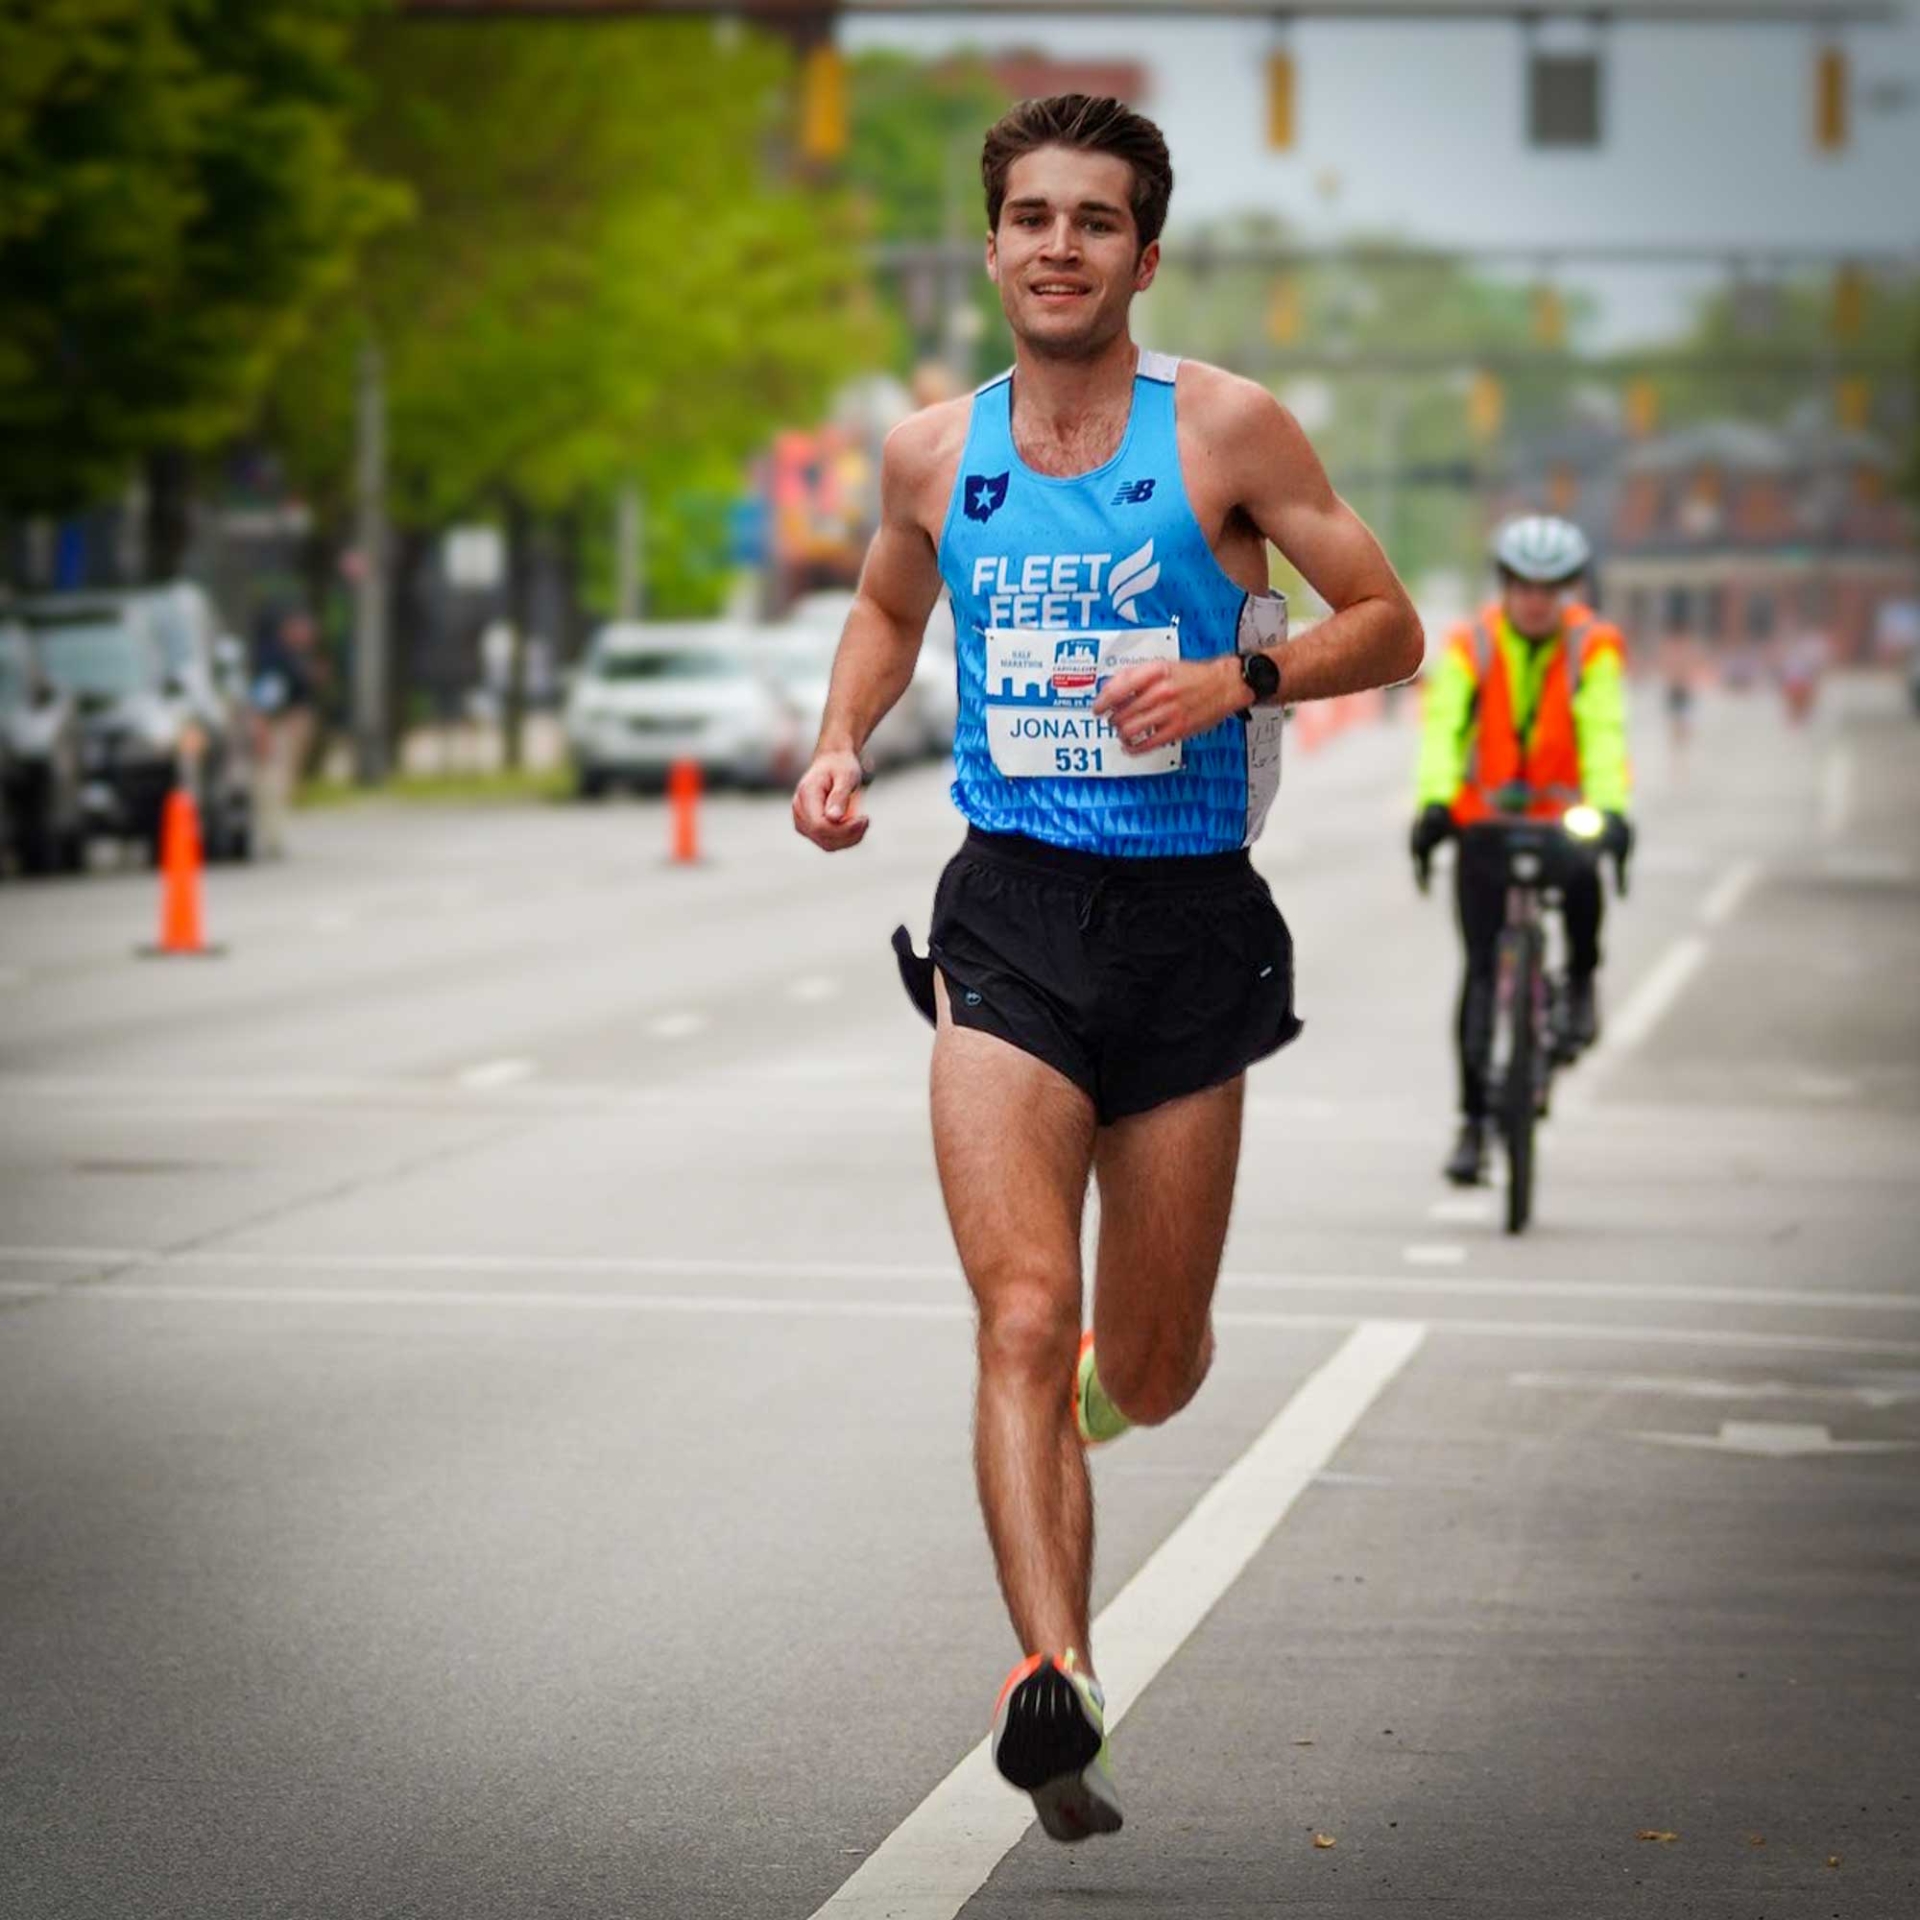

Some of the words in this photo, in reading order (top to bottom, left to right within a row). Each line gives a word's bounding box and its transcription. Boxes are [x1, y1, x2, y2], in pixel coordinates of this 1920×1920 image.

[972, 553, 1112, 596] FLEET
[989, 592, 1101, 629] FEET
[1010, 718, 1120, 739] JONATH
[1055, 747, 1103, 771] 531
